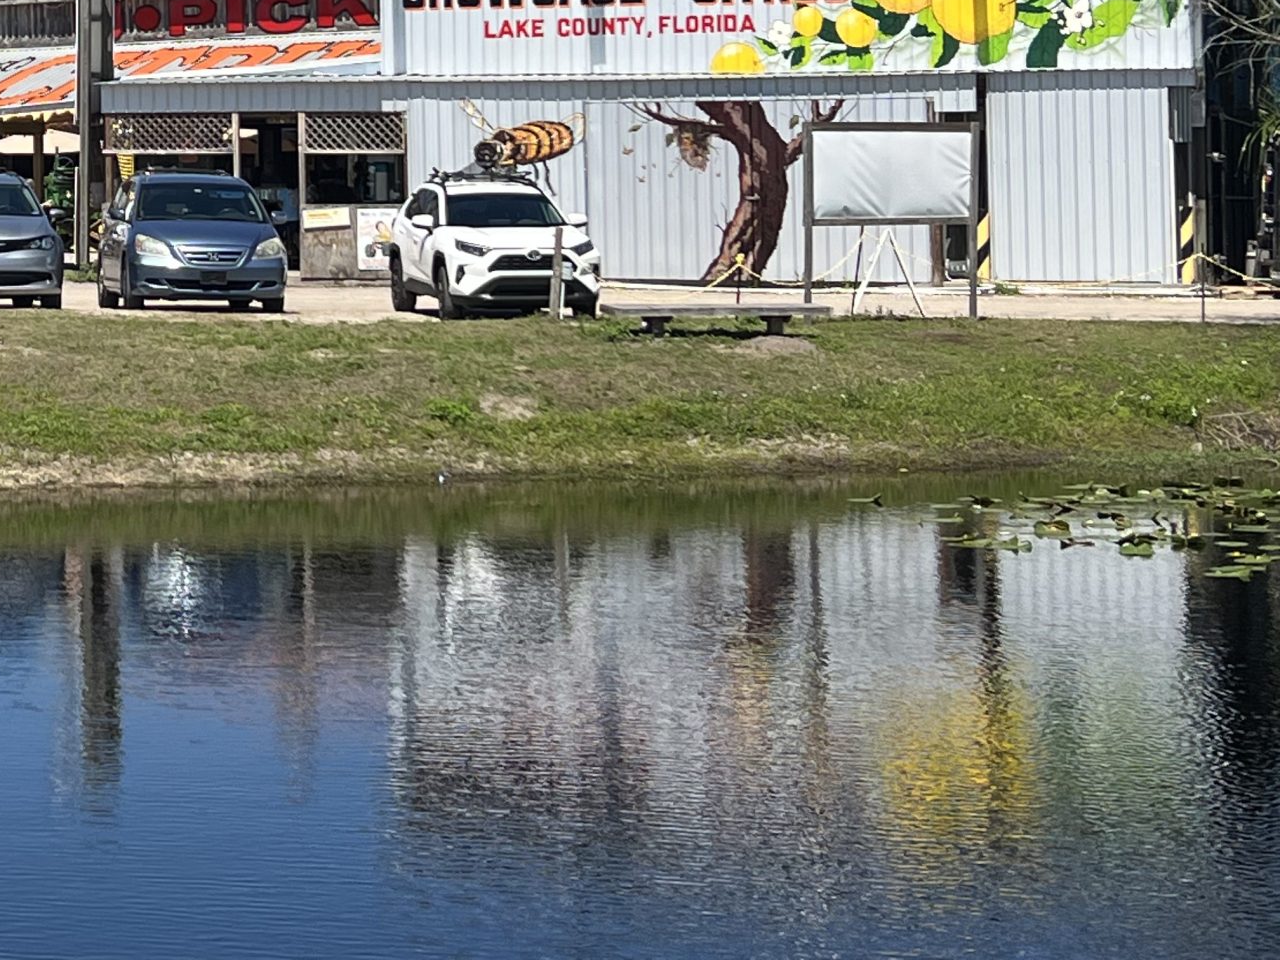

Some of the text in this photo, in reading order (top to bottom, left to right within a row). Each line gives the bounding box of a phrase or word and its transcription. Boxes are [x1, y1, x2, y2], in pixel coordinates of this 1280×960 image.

[483, 13, 755, 39] LAKE COUNTY, FLORIDA
